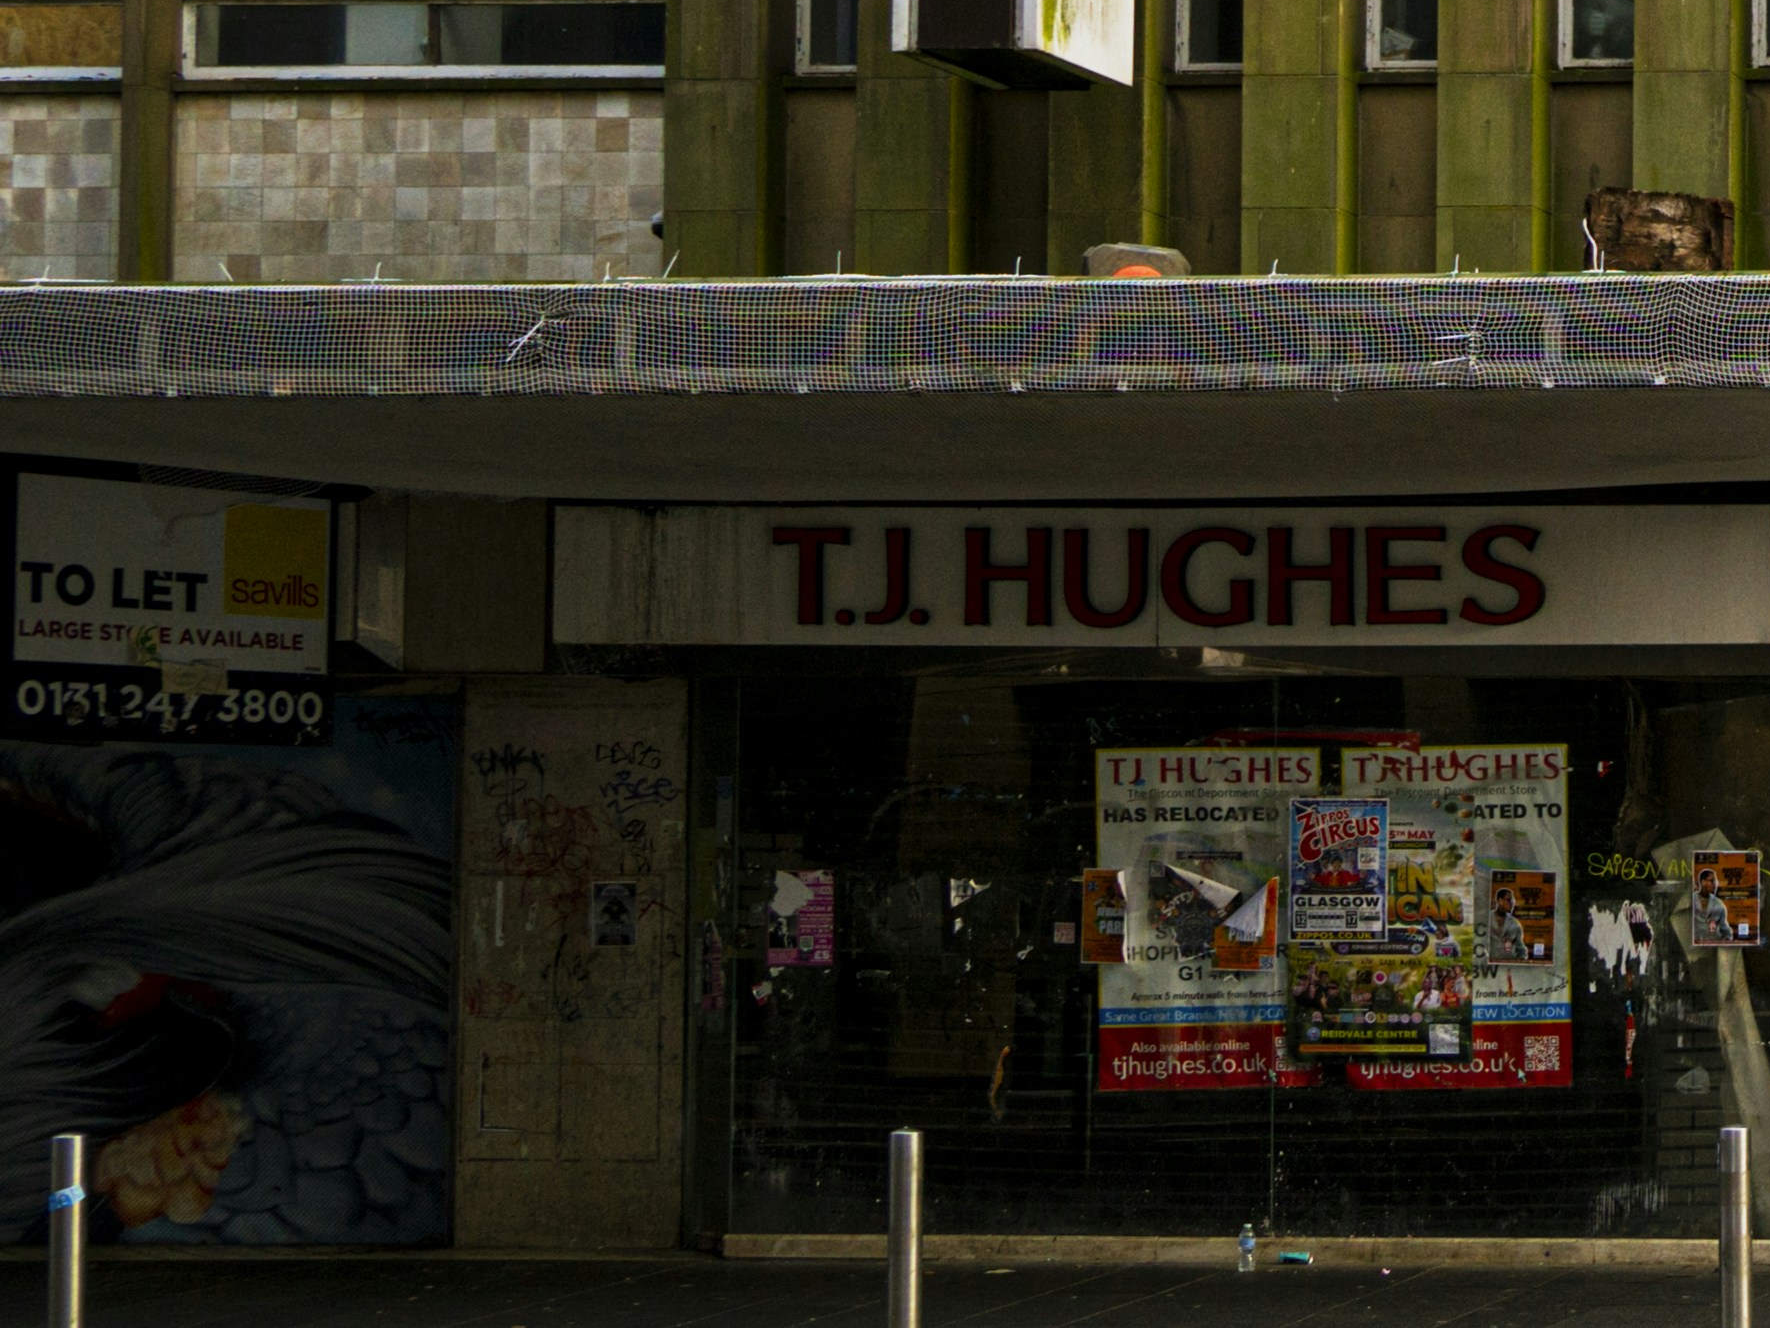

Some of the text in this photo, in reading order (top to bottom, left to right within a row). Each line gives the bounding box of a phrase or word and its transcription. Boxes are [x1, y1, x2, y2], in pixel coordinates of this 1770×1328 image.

[771, 525, 1546, 628] T.J. HUGHES
[20, 561, 208, 612] TO LET
[231, 574, 320, 608] savills
[19, 619, 304, 651] LARGE STE AVAILABLE
[15, 678, 109, 720] 0131
[215, 688, 325, 725] 3800
[1106, 757, 1313, 785] TJ HUGHES
[1407, 753, 1560, 782] HUGHES
[1127, 788, 1148, 798] The
[1198, 787, 1260, 799] Department
[1509, 784, 1538, 795] Store
[1103, 806, 1280, 823] HAS RELOCATED
[1533, 802, 1563, 818] TO
[1299, 816, 1380, 862] CIRCUS
[1407, 829, 1436, 840] MAY
[1587, 851, 1665, 881] SAIGON
[1294, 896, 1381, 908] GLASGOW
[1294, 931, 1373, 940] ZIPPOS.CO.UK
[1172, 991, 1203, 1001] minute
[1475, 989, 1497, 999] from
[1105, 1011, 1137, 1023] Same
[1138, 1010, 1170, 1022] Great
[1501, 1005, 1566, 1018] LOCATION
[1321, 1029, 1418, 1039] REIDVALE CENTRE
[1131, 1039, 1250, 1053] Also available online
[1111, 1051, 1268, 1080] tjhughes.co.uk
